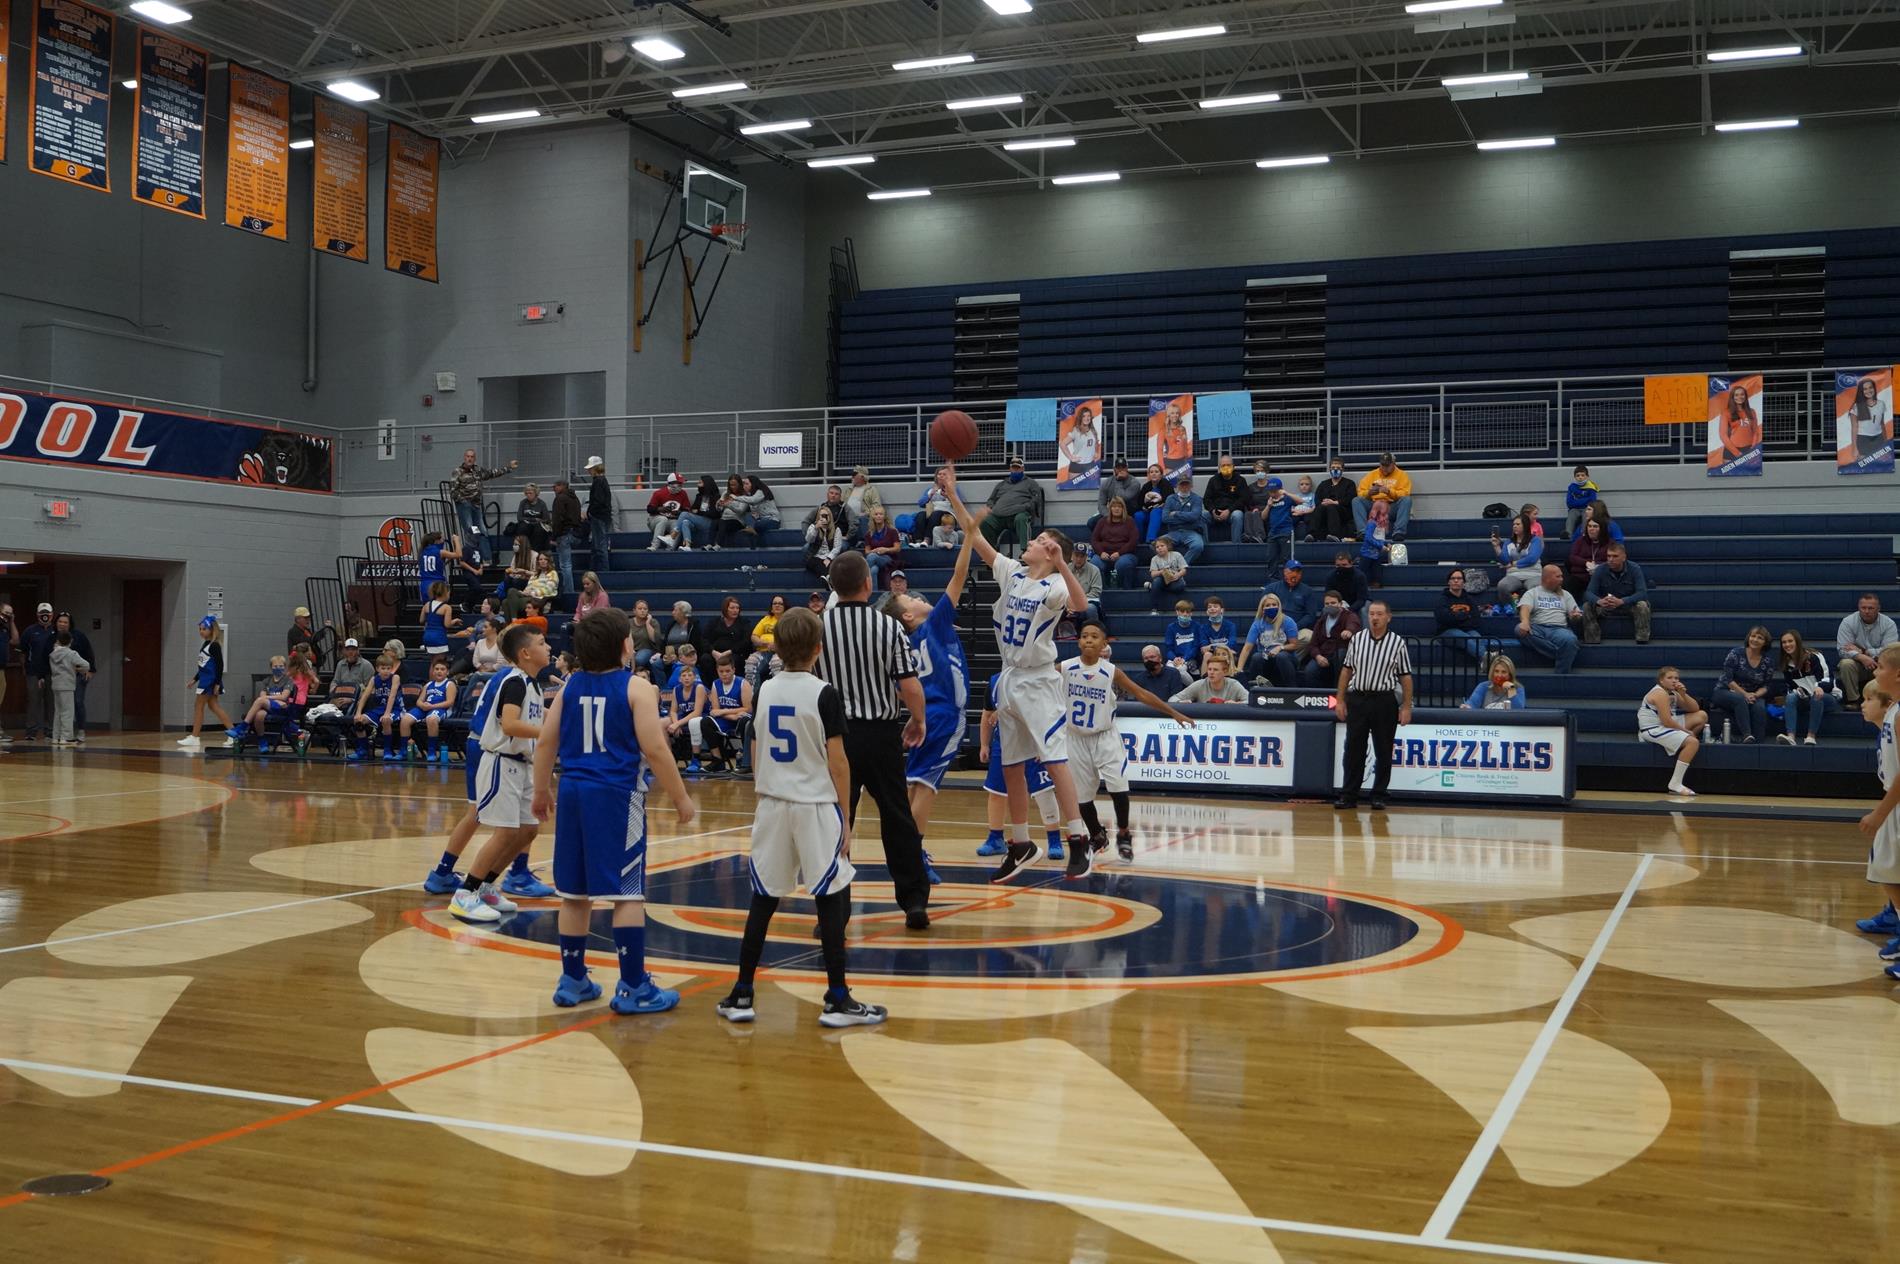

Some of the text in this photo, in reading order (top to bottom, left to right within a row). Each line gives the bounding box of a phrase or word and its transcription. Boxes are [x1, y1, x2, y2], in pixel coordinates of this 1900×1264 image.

[763, 446, 799, 454] VISITORS
[1721, 462, 1735, 474] AIDEN
[1858, 455, 1874, 468] OLIVIA
[423, 555, 437, 572] 10
[1002, 615, 1032, 648] 33
[1305, 696, 1329, 707] POSS
[1072, 700, 1096, 728] 21
[579, 696, 607, 754] 11
[1206, 723, 1218, 731] TO
[768, 705, 798, 763] 5
[1435, 728, 1500, 737] HOME OF THE
[1391, 738, 1554, 772] GRIZZLIES
[1038, 770, 1053, 784] R
[1141, 768, 1231, 780] HIGH SCHOOL
